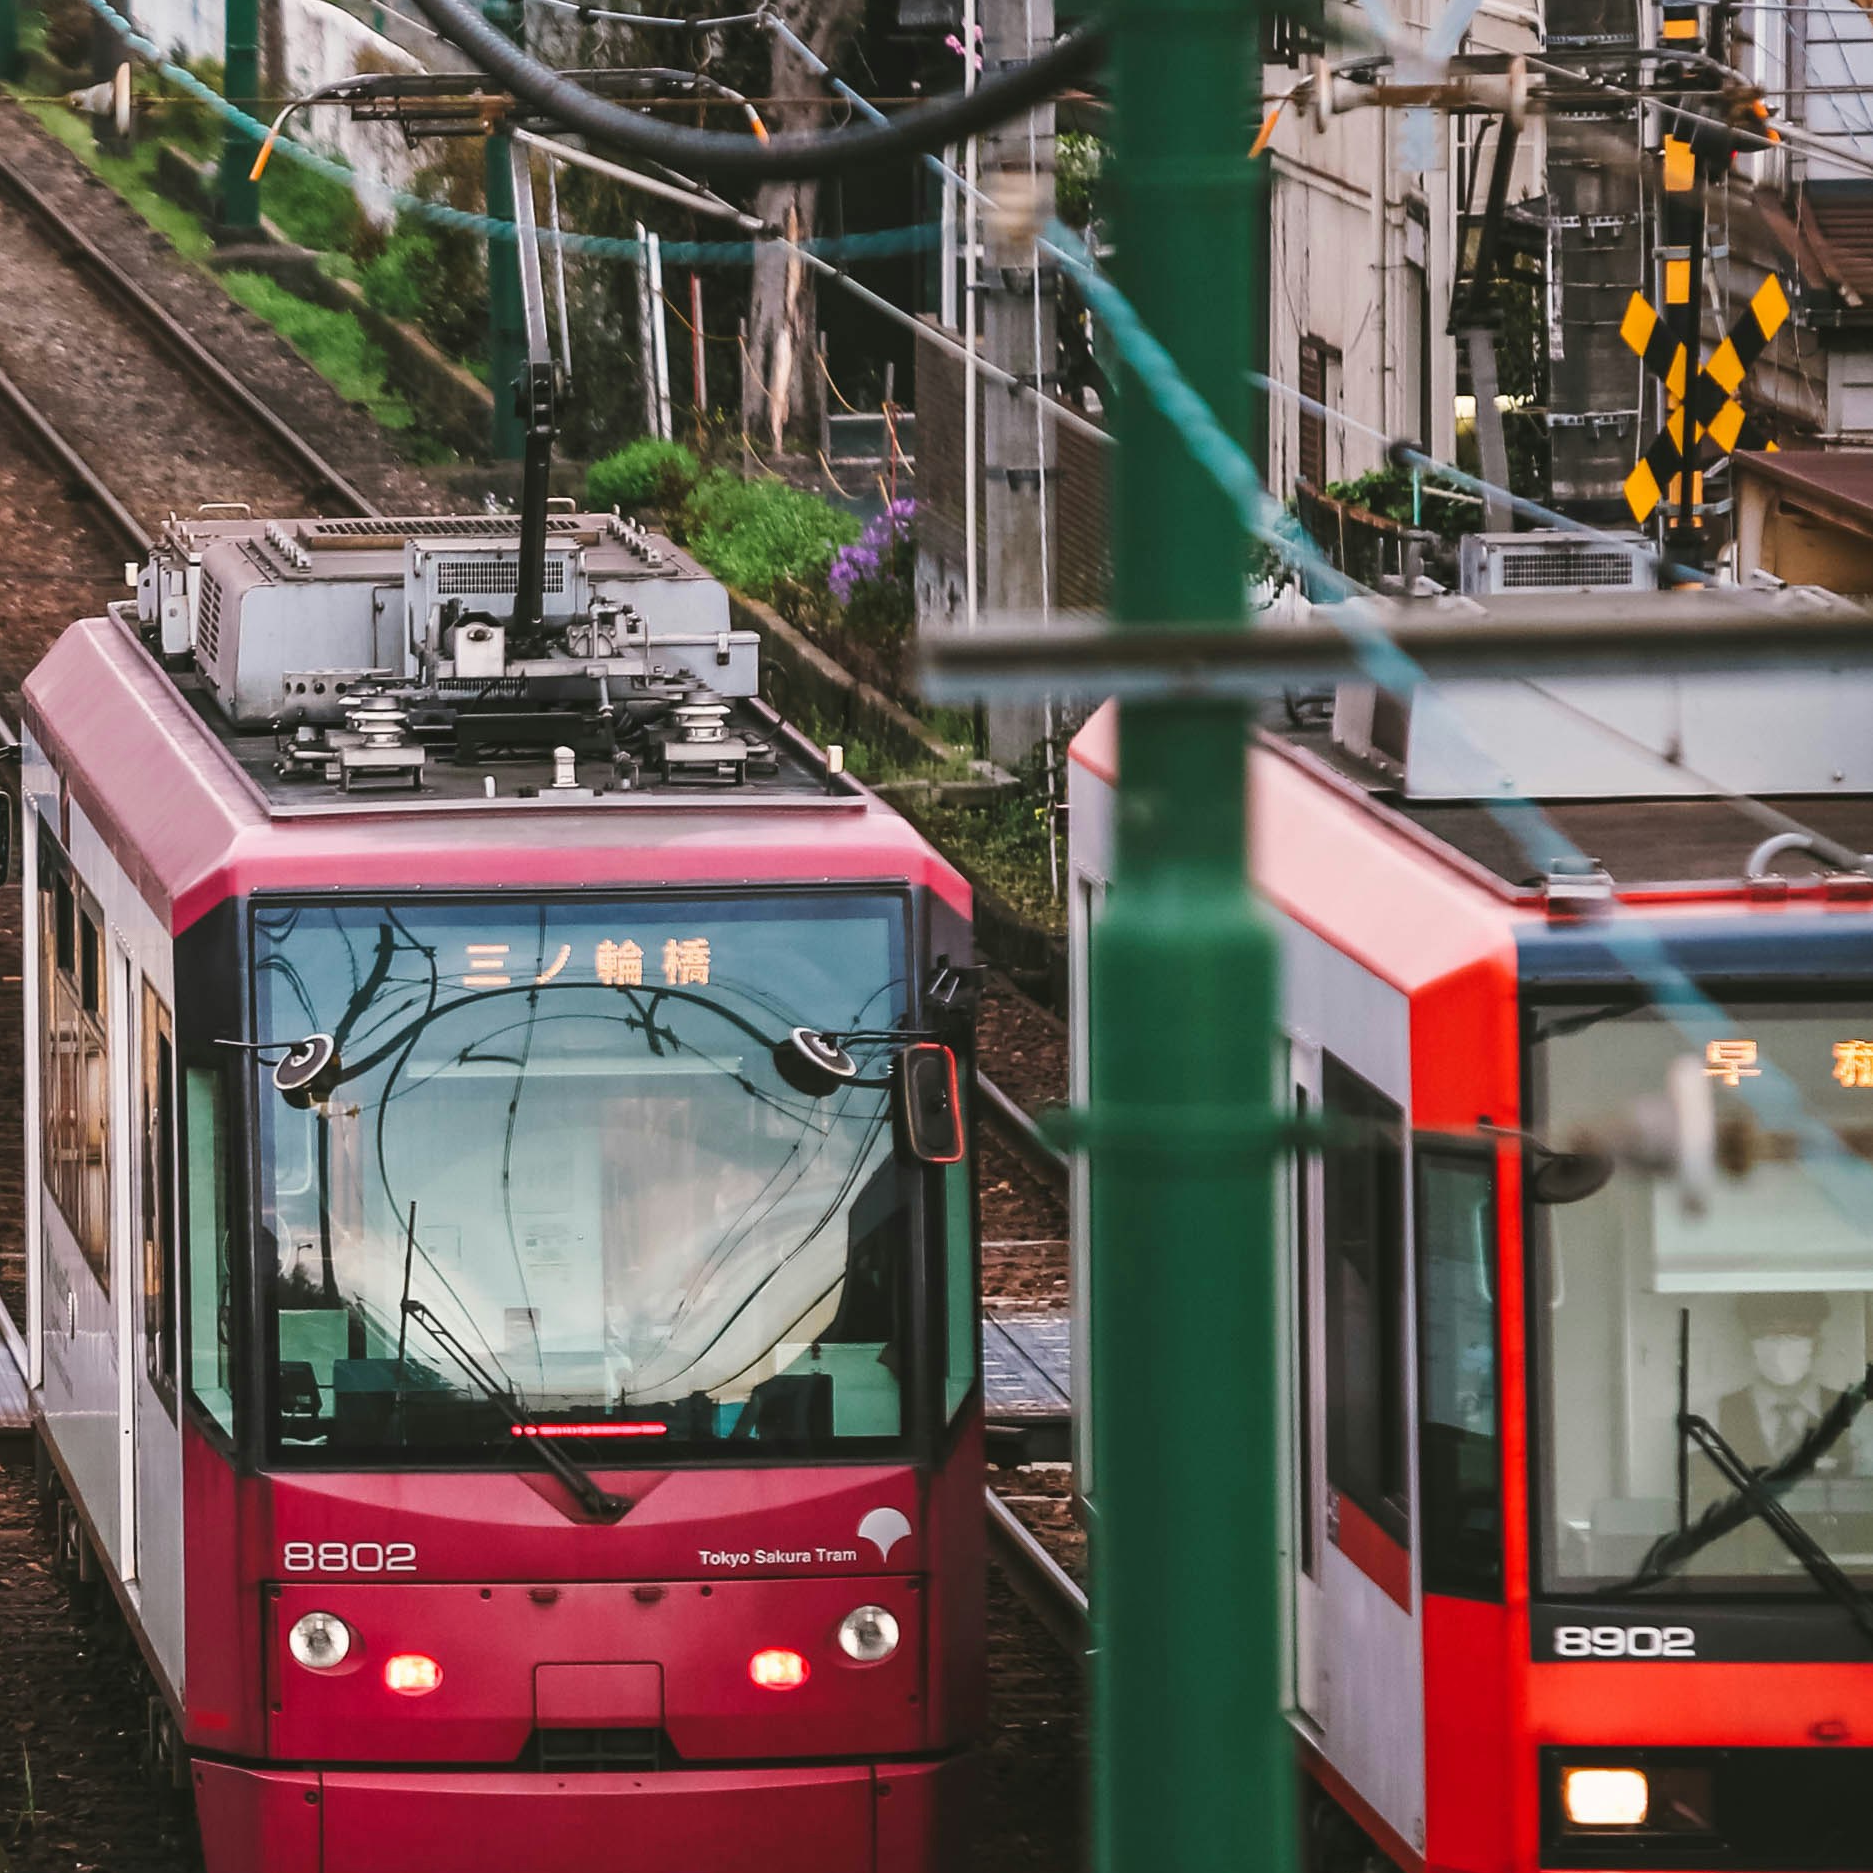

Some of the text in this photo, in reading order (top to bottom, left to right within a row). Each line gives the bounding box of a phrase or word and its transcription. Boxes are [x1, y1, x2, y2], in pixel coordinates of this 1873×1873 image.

[462, 938, 711, 986] 三ノ輪橋
[284, 1542, 417, 1571] 8802
[699, 1548, 857, 1567] Tokyo Sakura Tram
[1554, 1626, 1696, 1657] 8902
